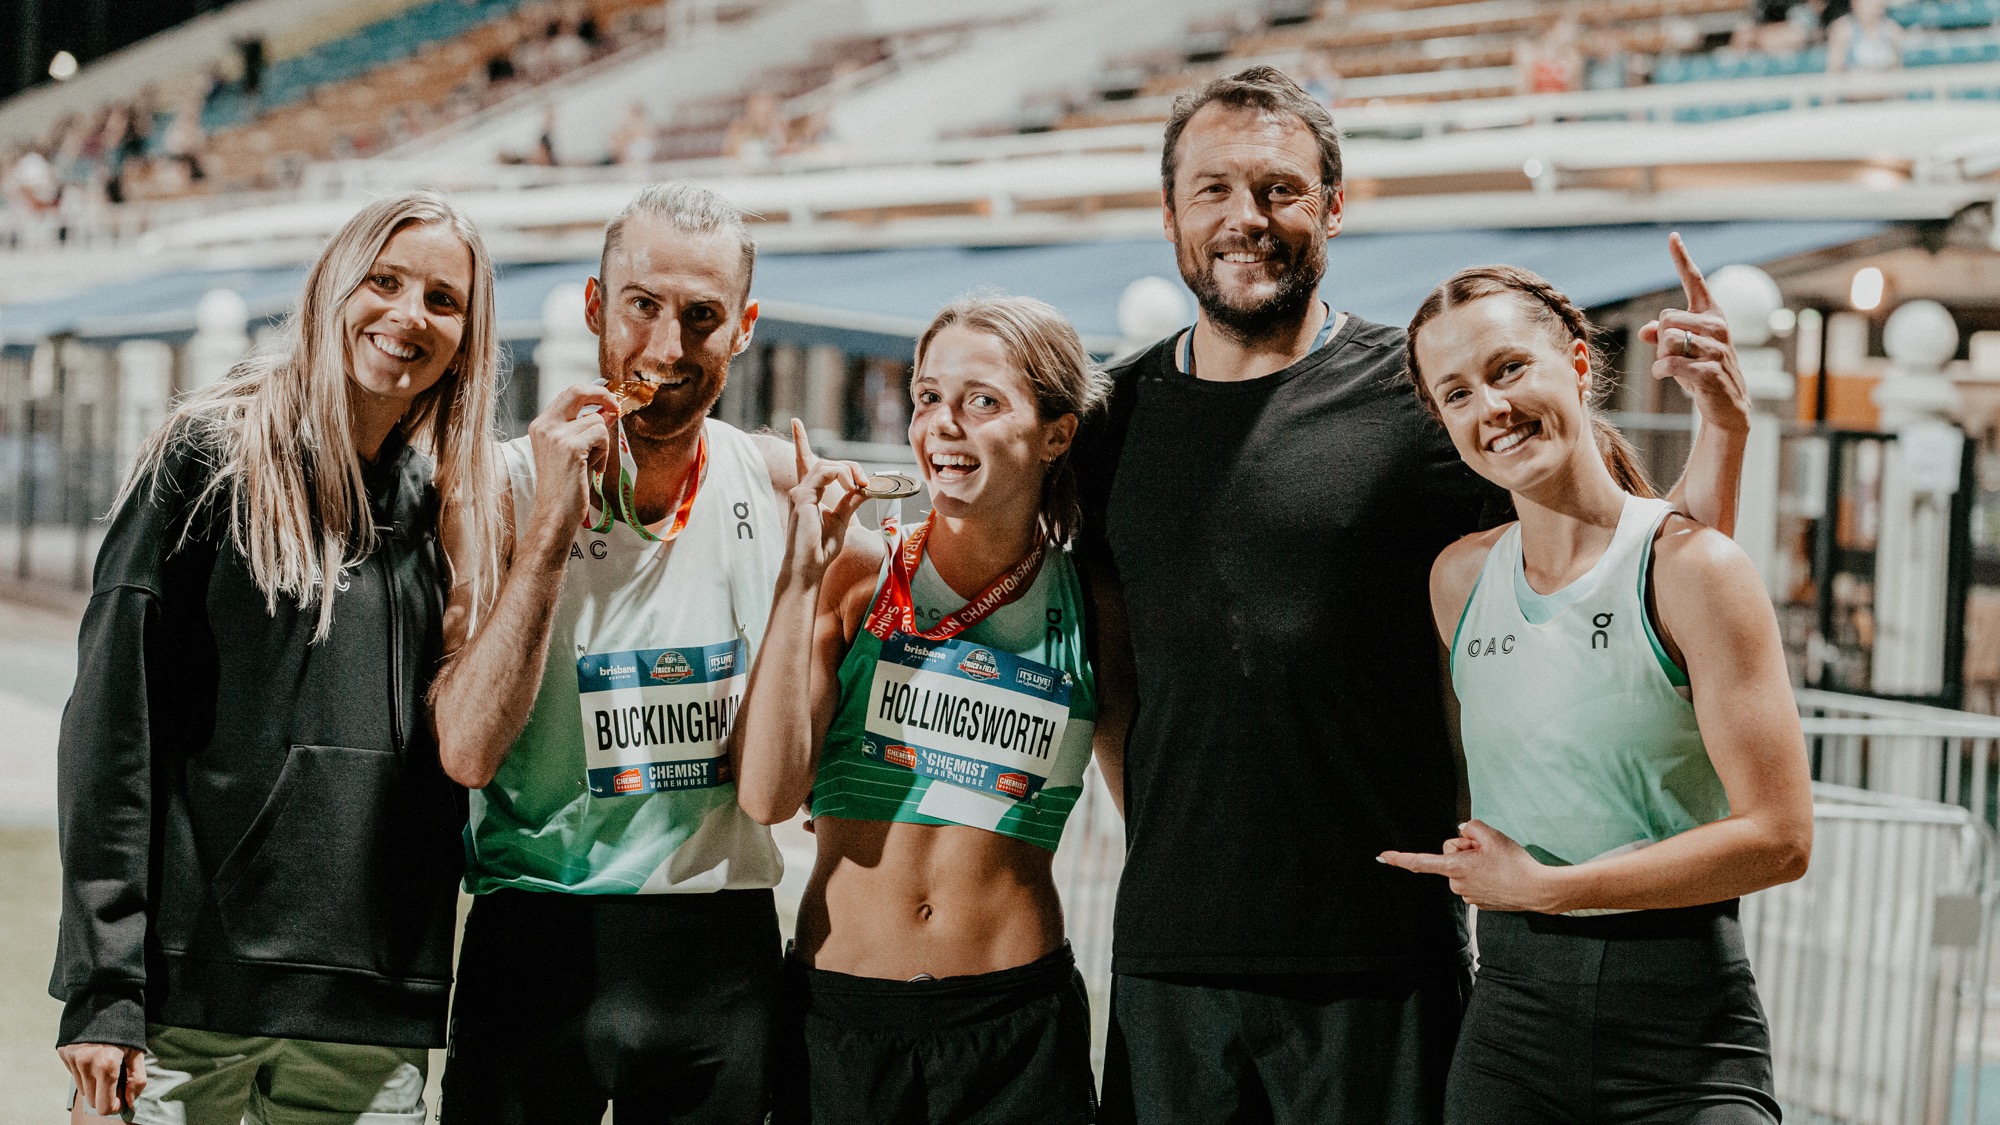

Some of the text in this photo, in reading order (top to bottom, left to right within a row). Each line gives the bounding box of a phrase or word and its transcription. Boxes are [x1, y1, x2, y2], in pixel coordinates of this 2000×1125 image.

[568, 540, 608, 560] AC
[311, 564, 351, 592] AC
[960, 546, 1042, 623] CHAMPIONSHIPS
[914, 605, 942, 621] AC
[903, 643, 947, 660] brisbane
[1467, 634, 1516, 658] OAC
[599, 664, 637, 676] brisbane
[674, 665, 689, 673] FIELD
[1032, 674, 1051, 687] LIVE!
[879, 680, 1056, 760] HOLLINGSWORTH
[887, 748, 916, 762] CHEMIST
[648, 762, 709, 780] CHEMIST
[927, 752, 989, 779] CHEMIST
[616, 775, 641, 785] CHEMIST
[649, 777, 709, 789] WAREHOUSE
[926, 766, 984, 787] WAREHOUSE
[999, 777, 1027, 791] CHEMIST
